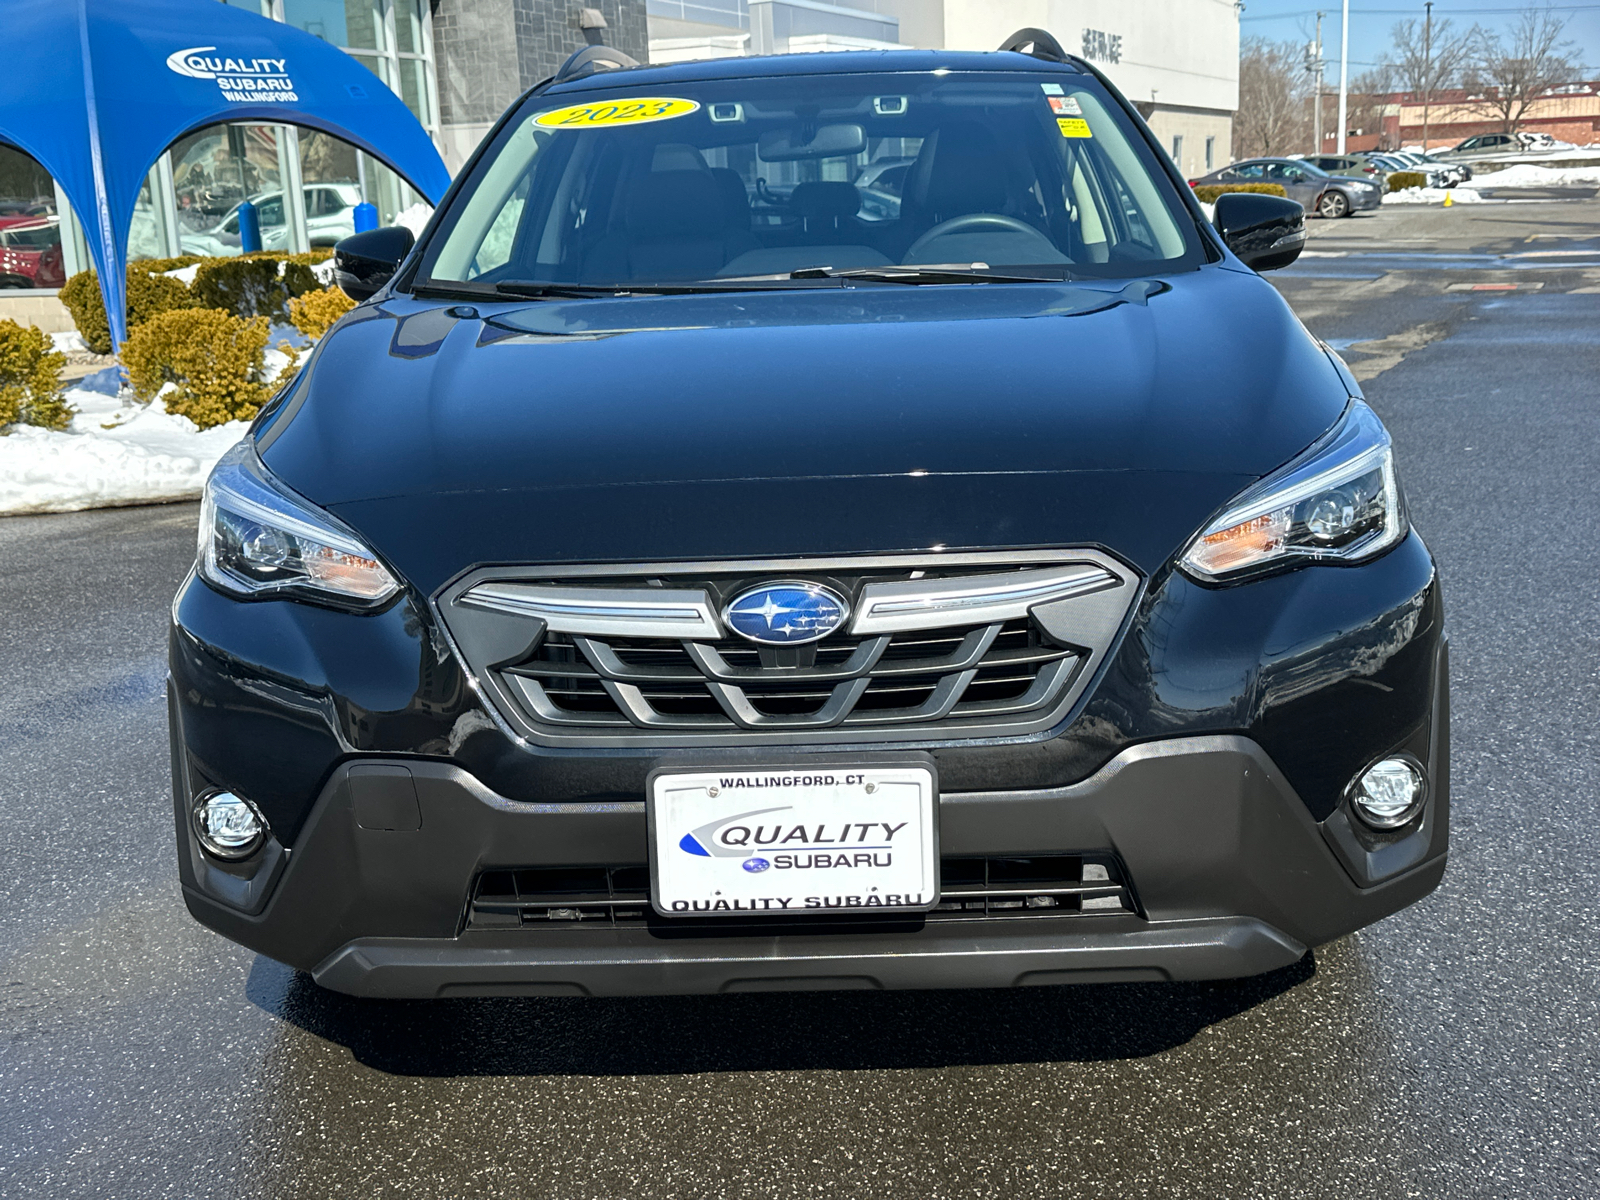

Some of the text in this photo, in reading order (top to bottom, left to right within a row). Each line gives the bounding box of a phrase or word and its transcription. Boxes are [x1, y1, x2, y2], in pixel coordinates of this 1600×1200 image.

[187, 56, 286, 73] QUALITY
[217, 77, 293, 91] SUBARU
[221, 91, 299, 103] WALLINGFORD
[558, 102, 674, 125] 2023
[719, 774, 865, 789] WALLINGFORD, CT
[720, 822, 909, 847] QUALITY
[773, 853, 893, 870] SUBARU
[671, 893, 922, 912] QUALITY SUBARU
